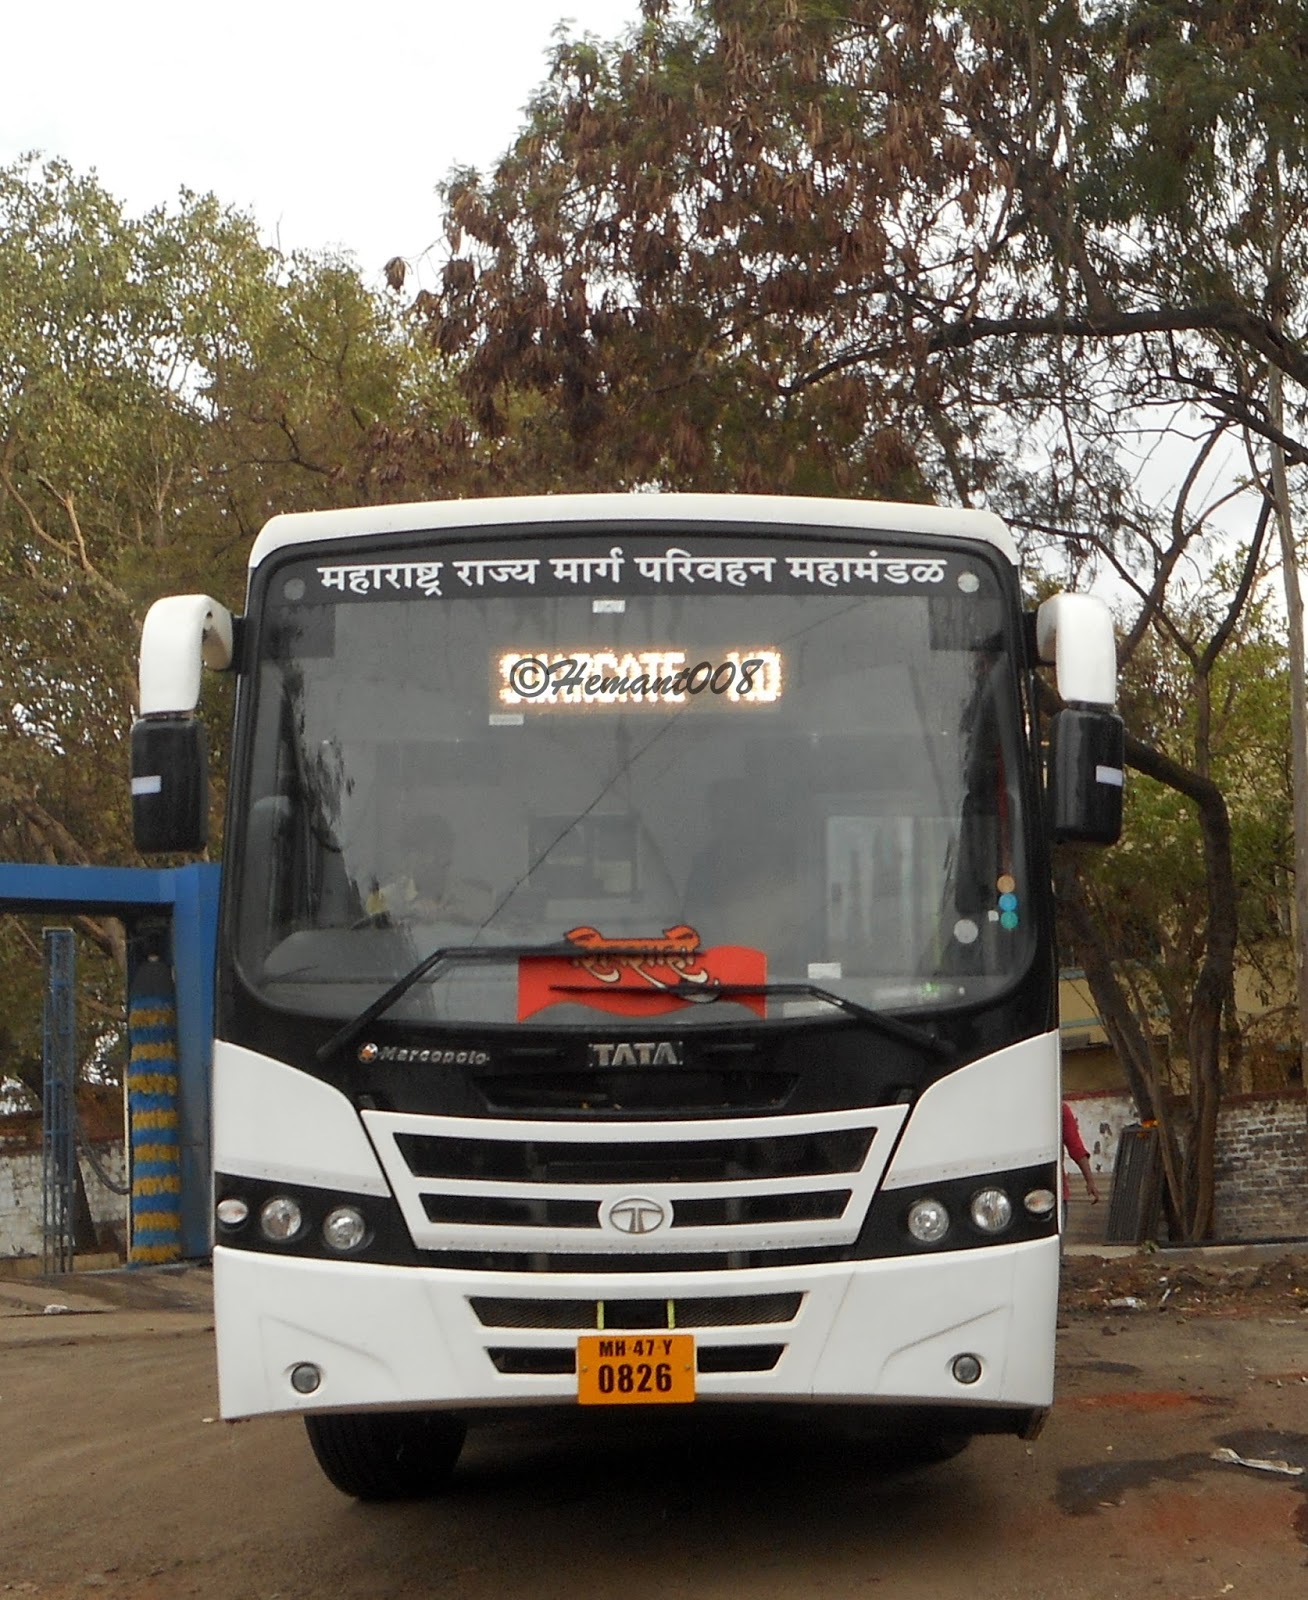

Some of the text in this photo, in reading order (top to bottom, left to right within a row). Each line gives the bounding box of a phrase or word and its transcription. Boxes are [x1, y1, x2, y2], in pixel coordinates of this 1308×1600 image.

[316, 547, 947, 596] महाराष्ट्र राज्य मार्ग परिवहन महामंडळ
[592, 1042, 678, 1066] TATA
[599, 1339, 673, 1357] MH 47 Y
[598, 1363, 673, 1394] 0826
